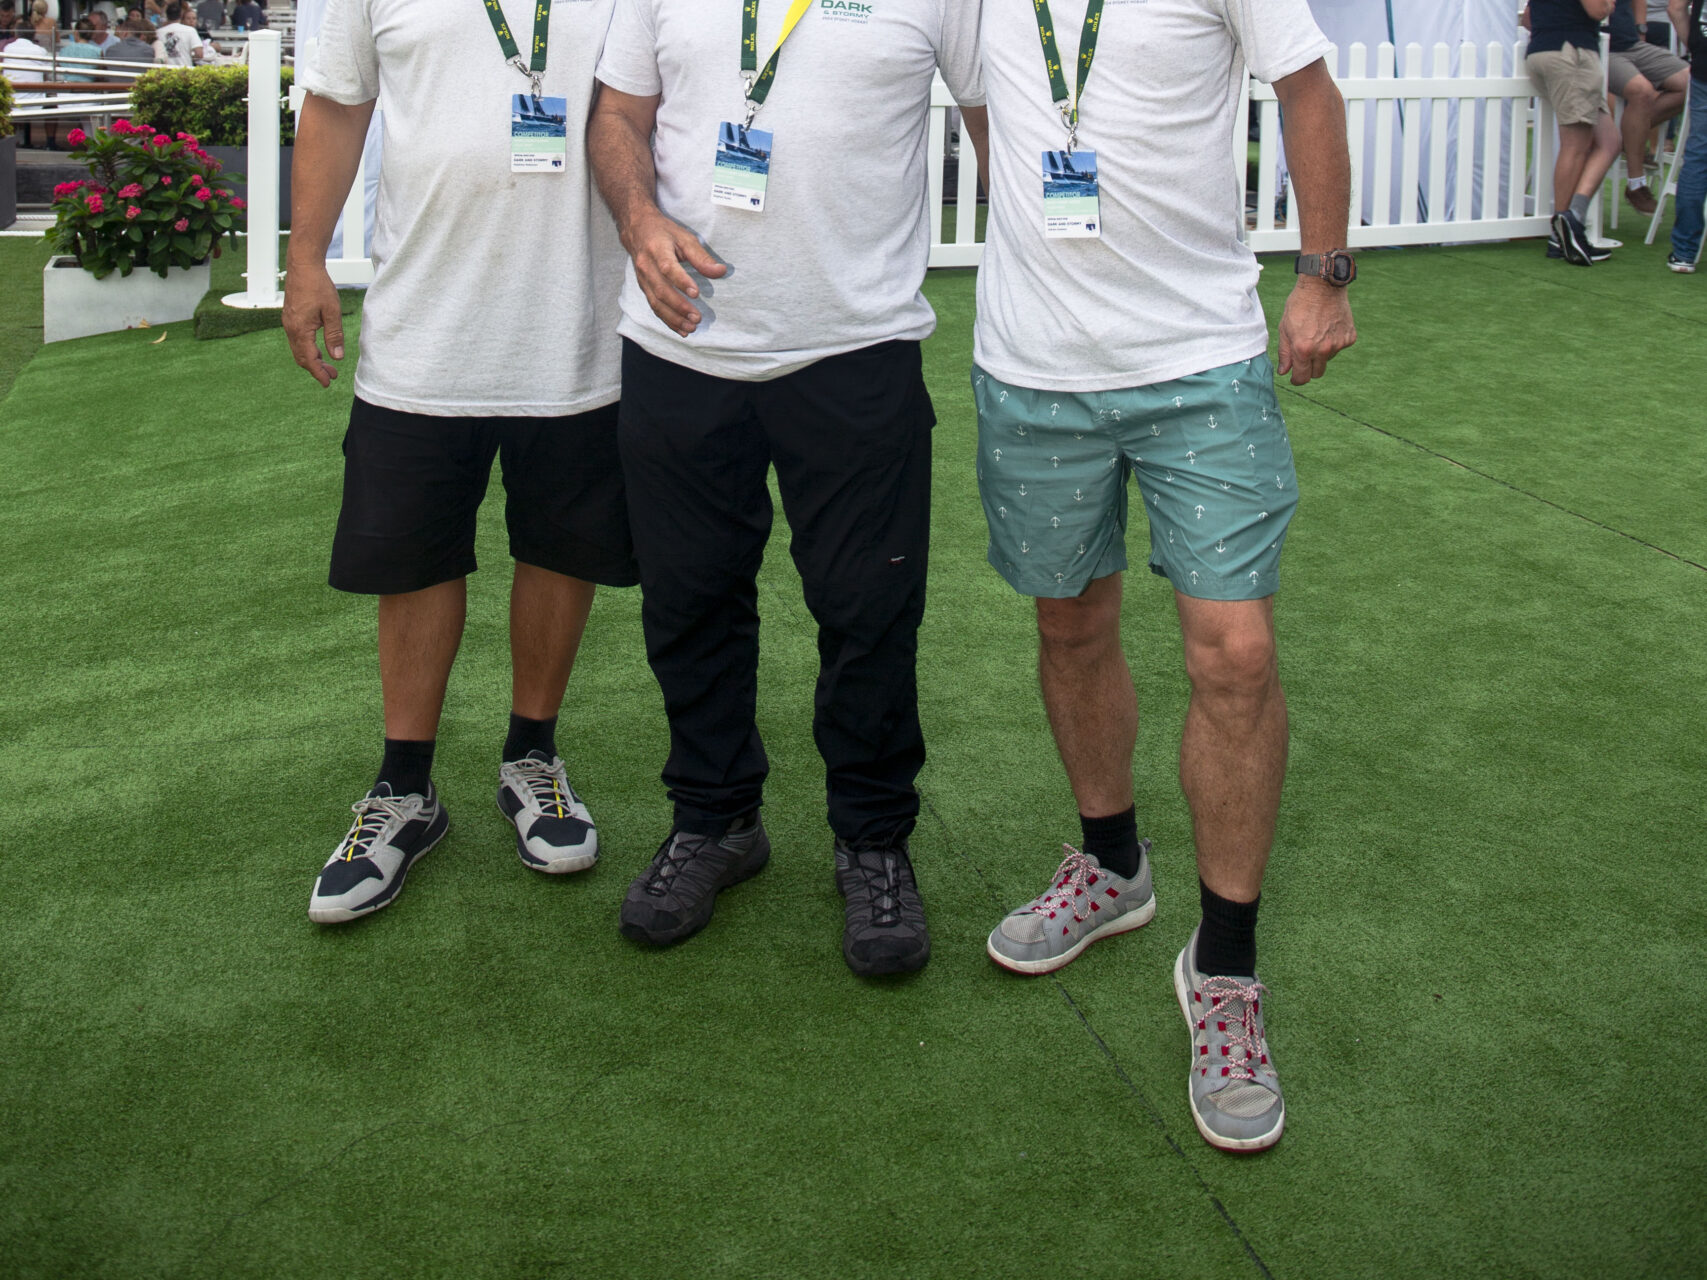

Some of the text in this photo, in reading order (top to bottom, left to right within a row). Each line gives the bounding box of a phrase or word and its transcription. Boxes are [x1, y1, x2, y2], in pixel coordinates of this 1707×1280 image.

[821, 0, 872, 13] DARK
[832, 10, 870, 19] STORMY
[1091, 12, 1100, 32] ROLEX
[1039, 26, 1047, 45] ROLEX
[1085, 48, 1094, 68] ROLEX
[1047, 59, 1055, 79] ROLEX
